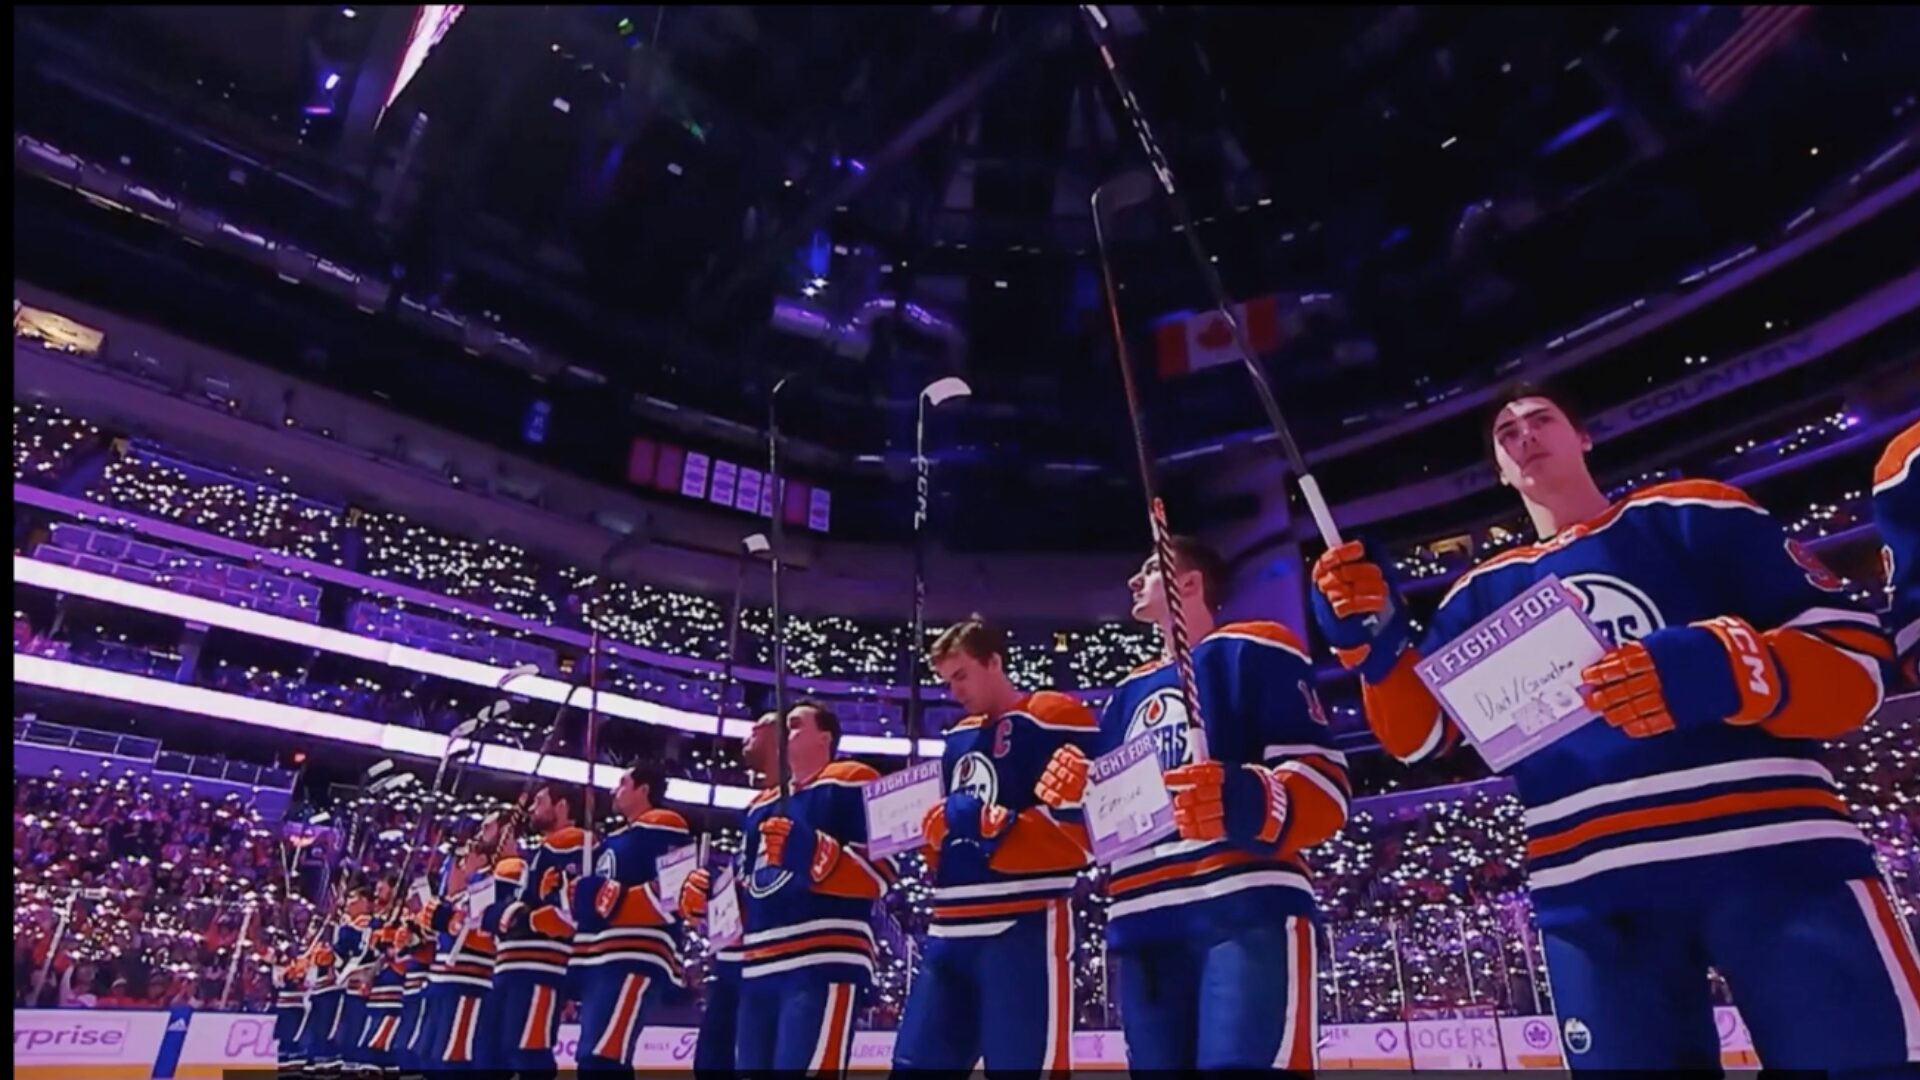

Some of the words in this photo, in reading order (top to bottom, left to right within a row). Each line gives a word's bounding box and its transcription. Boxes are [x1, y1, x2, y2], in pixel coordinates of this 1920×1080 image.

[1423, 664, 1441, 685] I
[1440, 617, 1511, 674] FIGHT
[1508, 586, 1562, 629] FOR
[993, 718, 1014, 759] C
[1094, 750, 1127, 781] IGHT
[1128, 733, 1153, 762] FOR
[874, 773, 911, 795] FIGHT
[912, 763, 940, 784] FOR
[14, 1024, 123, 1051] rprise
